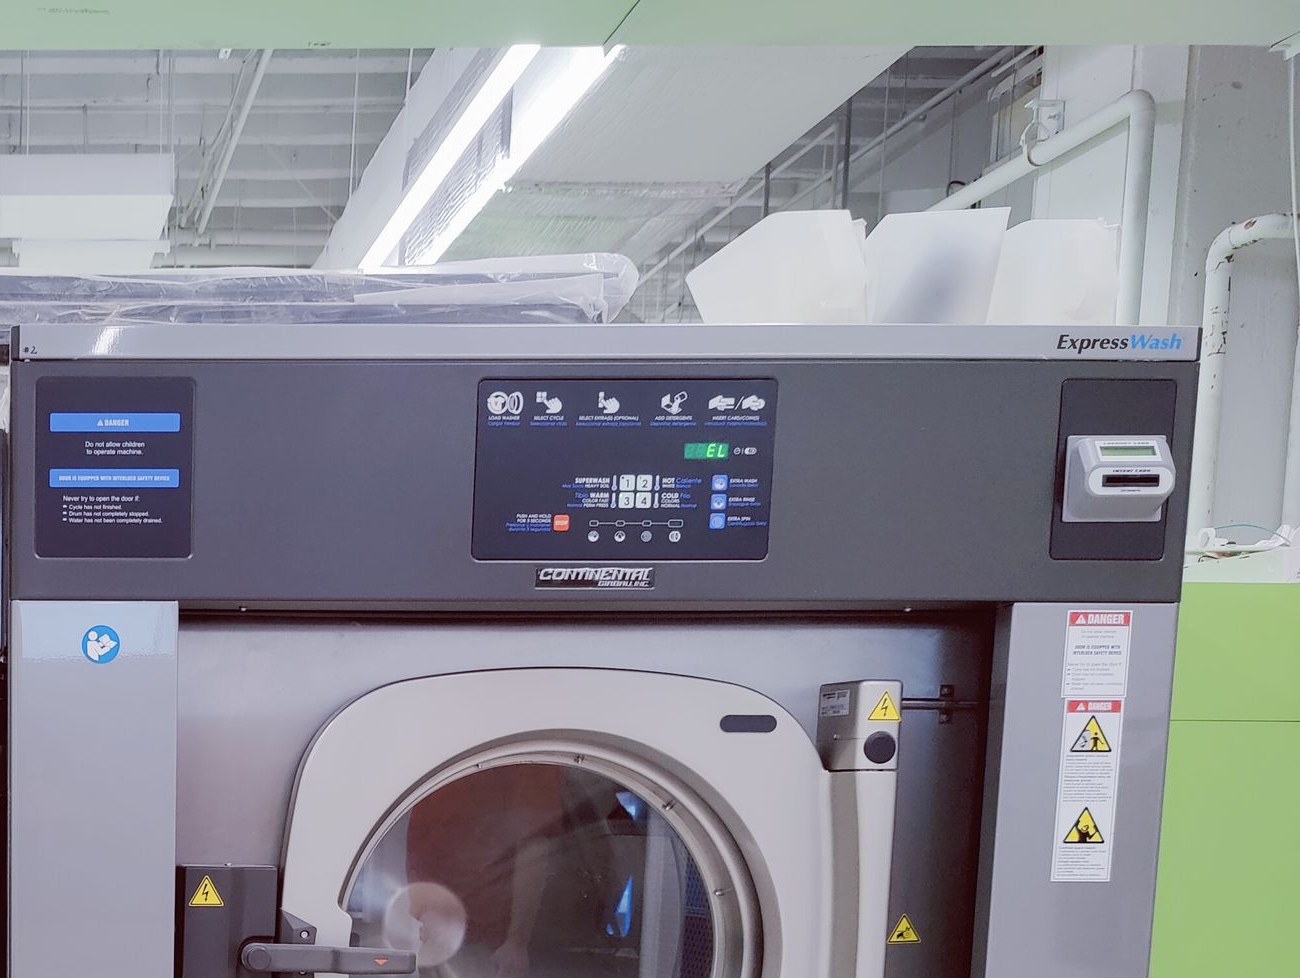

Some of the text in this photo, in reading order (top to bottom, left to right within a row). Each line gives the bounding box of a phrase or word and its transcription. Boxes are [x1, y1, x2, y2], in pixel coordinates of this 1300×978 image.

[1057, 333, 1182, 354] ExpressWash
[624, 496, 647, 506] 3 4
[539, 568, 651, 580] CONTINENTAL
[1087, 613, 1124, 625] DANGER
